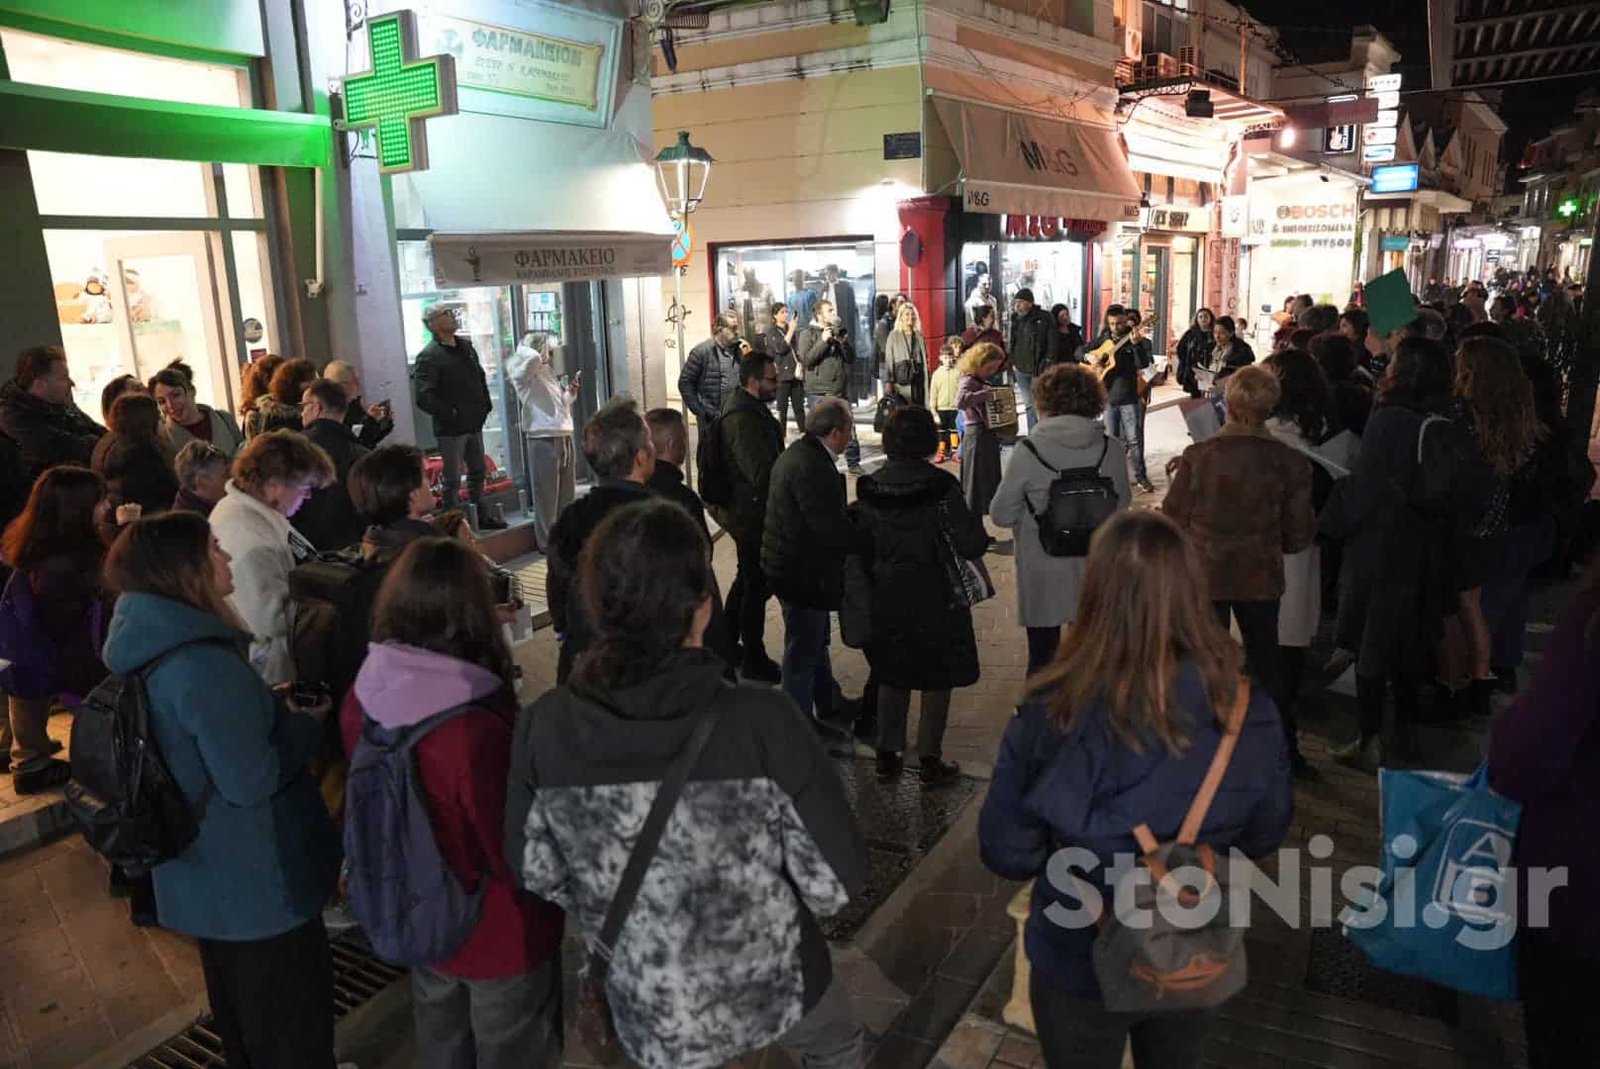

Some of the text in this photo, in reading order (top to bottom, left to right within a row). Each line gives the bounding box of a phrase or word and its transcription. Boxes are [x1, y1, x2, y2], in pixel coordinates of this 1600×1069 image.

[1019, 140, 1078, 177] M&G
[1289, 203, 1355, 220] BOSCH
[514, 248, 615, 267] ΦΑΡΜΑΚΕΙΟ
